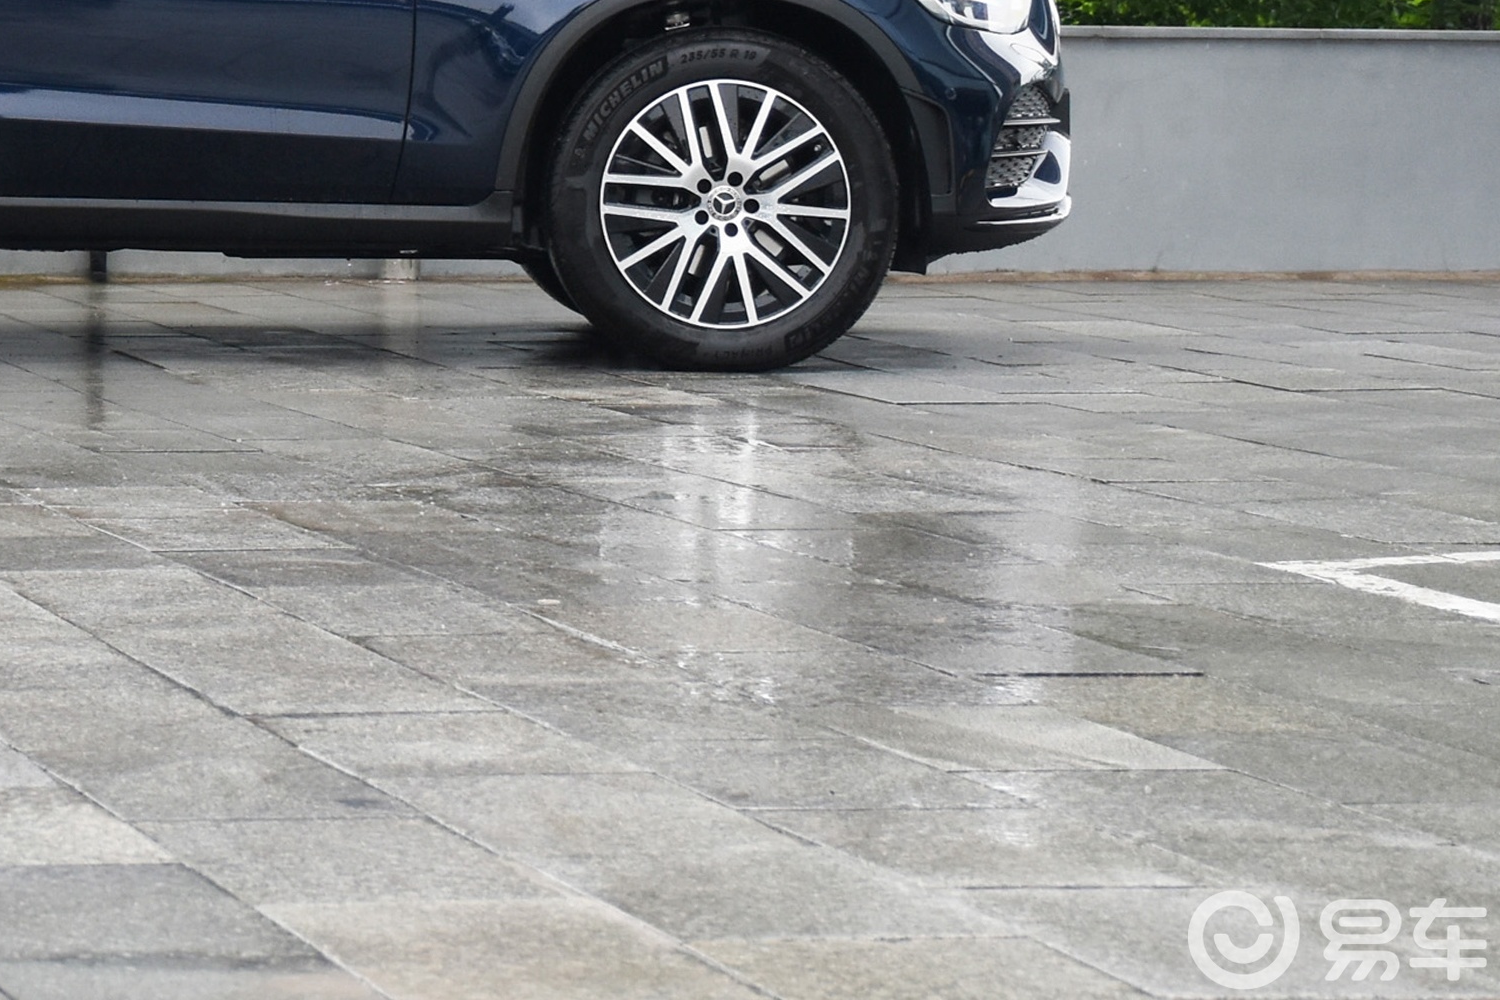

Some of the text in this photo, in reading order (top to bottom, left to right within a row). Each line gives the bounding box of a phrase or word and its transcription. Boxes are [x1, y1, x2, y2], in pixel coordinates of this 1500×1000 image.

[680, 47, 727, 64] 235/55
[729, 48, 740, 59] R
[583, 60, 664, 142] MICHELIN
